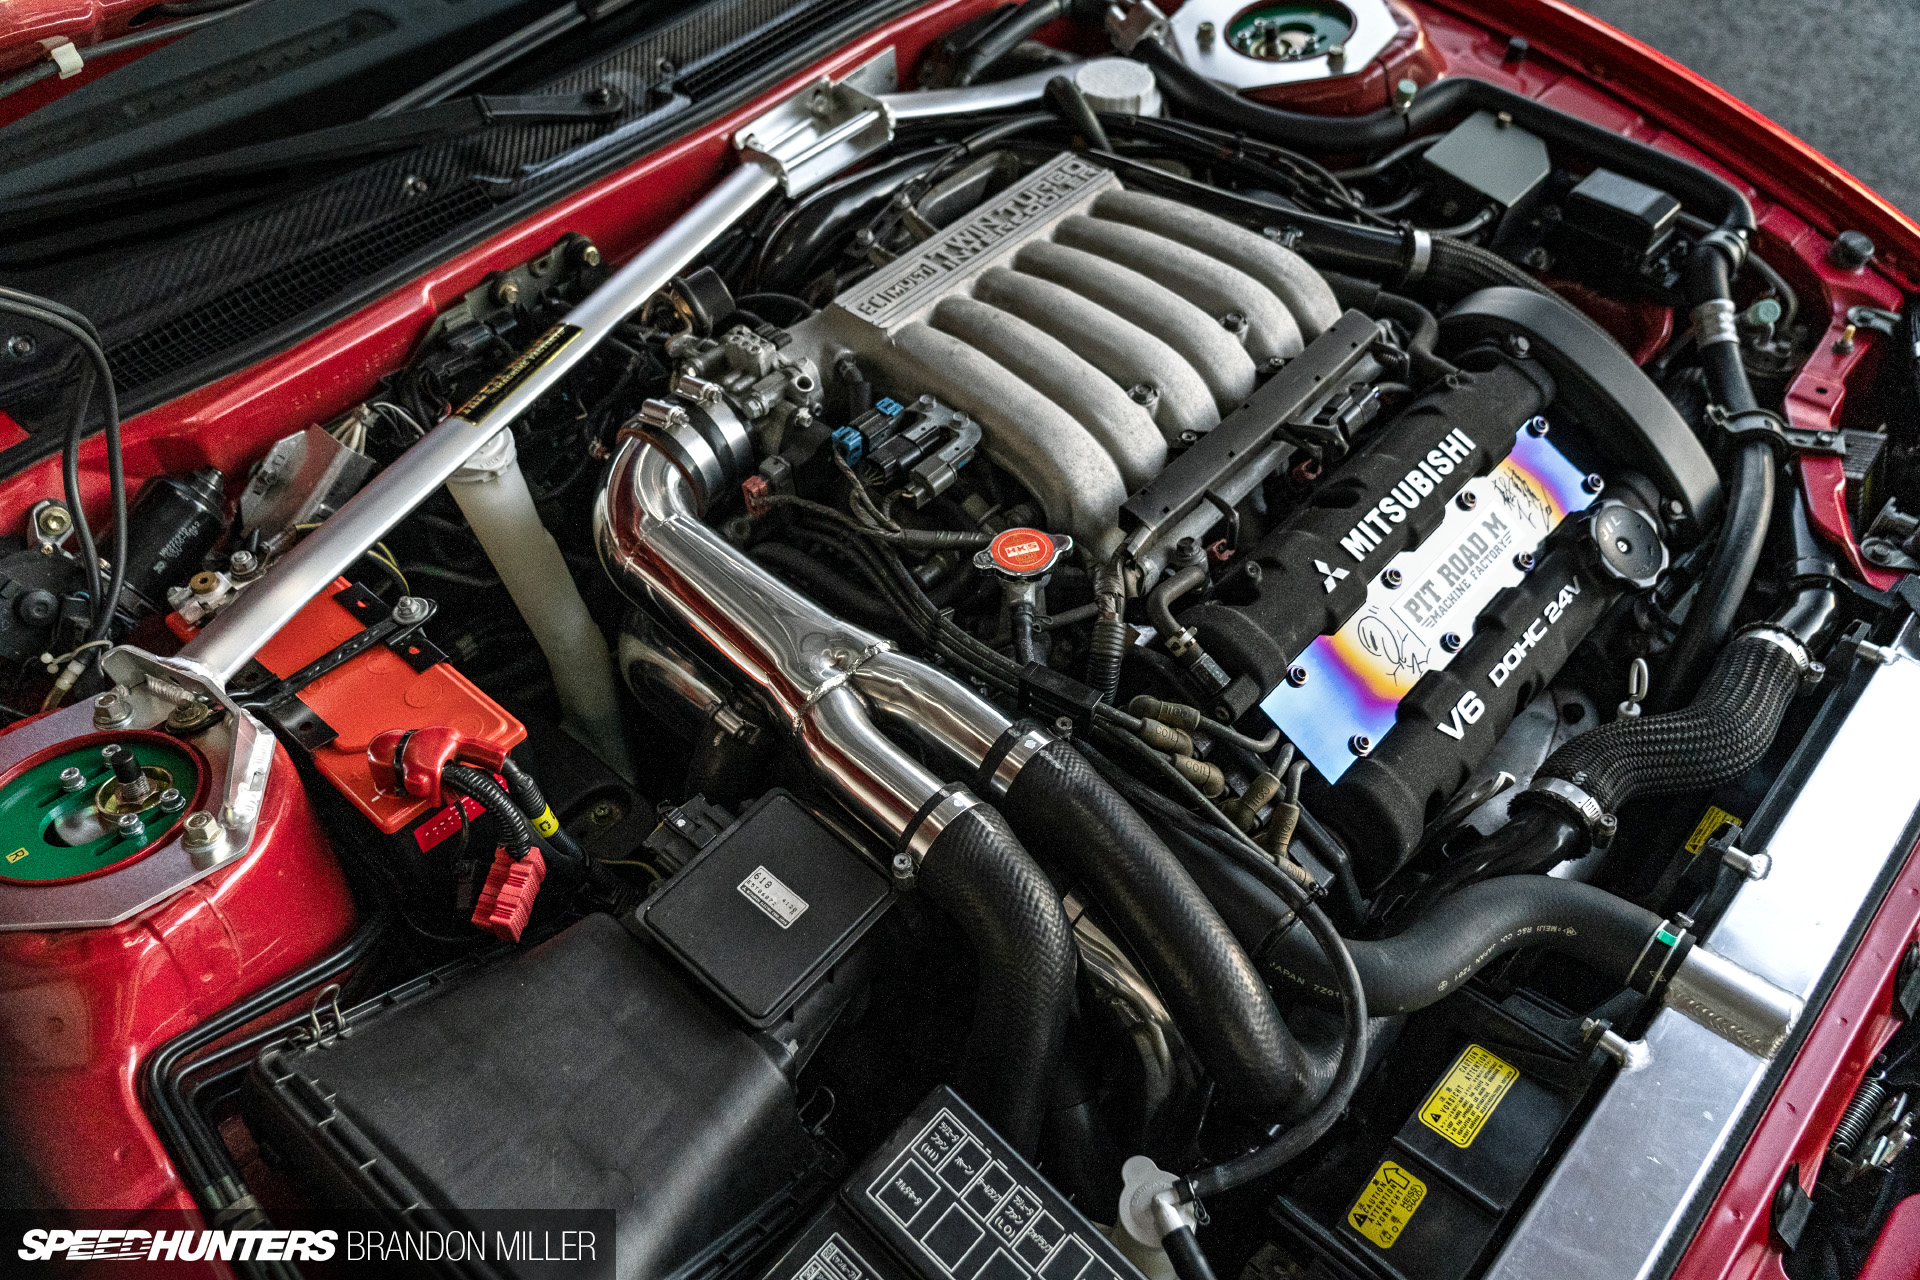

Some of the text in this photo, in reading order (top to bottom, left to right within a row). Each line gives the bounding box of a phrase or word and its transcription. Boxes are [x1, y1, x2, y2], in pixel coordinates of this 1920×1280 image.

[1340, 428, 1476, 562] MITSUBISHI
[1006, 542, 1038, 556] HKS
[1403, 512, 1508, 623] PIT ROAD M
[1430, 539, 1507, 624] MACHINE FACTORY
[1437, 576, 1581, 740] V6 DOHC 24V
[1156, 726, 1177, 741] COIL
[1186, 760, 1208, 776] COIL
[9, 850, 24, 861] R
[754, 872, 772, 888] 618
[1475, 943, 1496, 964] JAPAN
[1268, 961, 1306, 986] JAPAN
[1459, 1051, 1478, 1073] CAUTION
[1440, 1085, 1464, 1114] VORSICHT
[1464, 1054, 1488, 1082] ATTENTION
[920, 1142, 939, 1162] (HI)
[930, 1132, 950, 1151] ファン
[954, 1156, 974, 1175] ホーン
[1363, 1182, 1386, 1214] CAUTION
[1368, 1183, 1397, 1223] ATTENTION
[1376, 1190, 1403, 1226] VORSICHT
[1400, 1186, 1418, 1208] HEISS
[1004, 1204, 1024, 1224] ファン
[1386, 1189, 1422, 1241] HOT CHAUD
[994, 1215, 1016, 1238] (LO)
